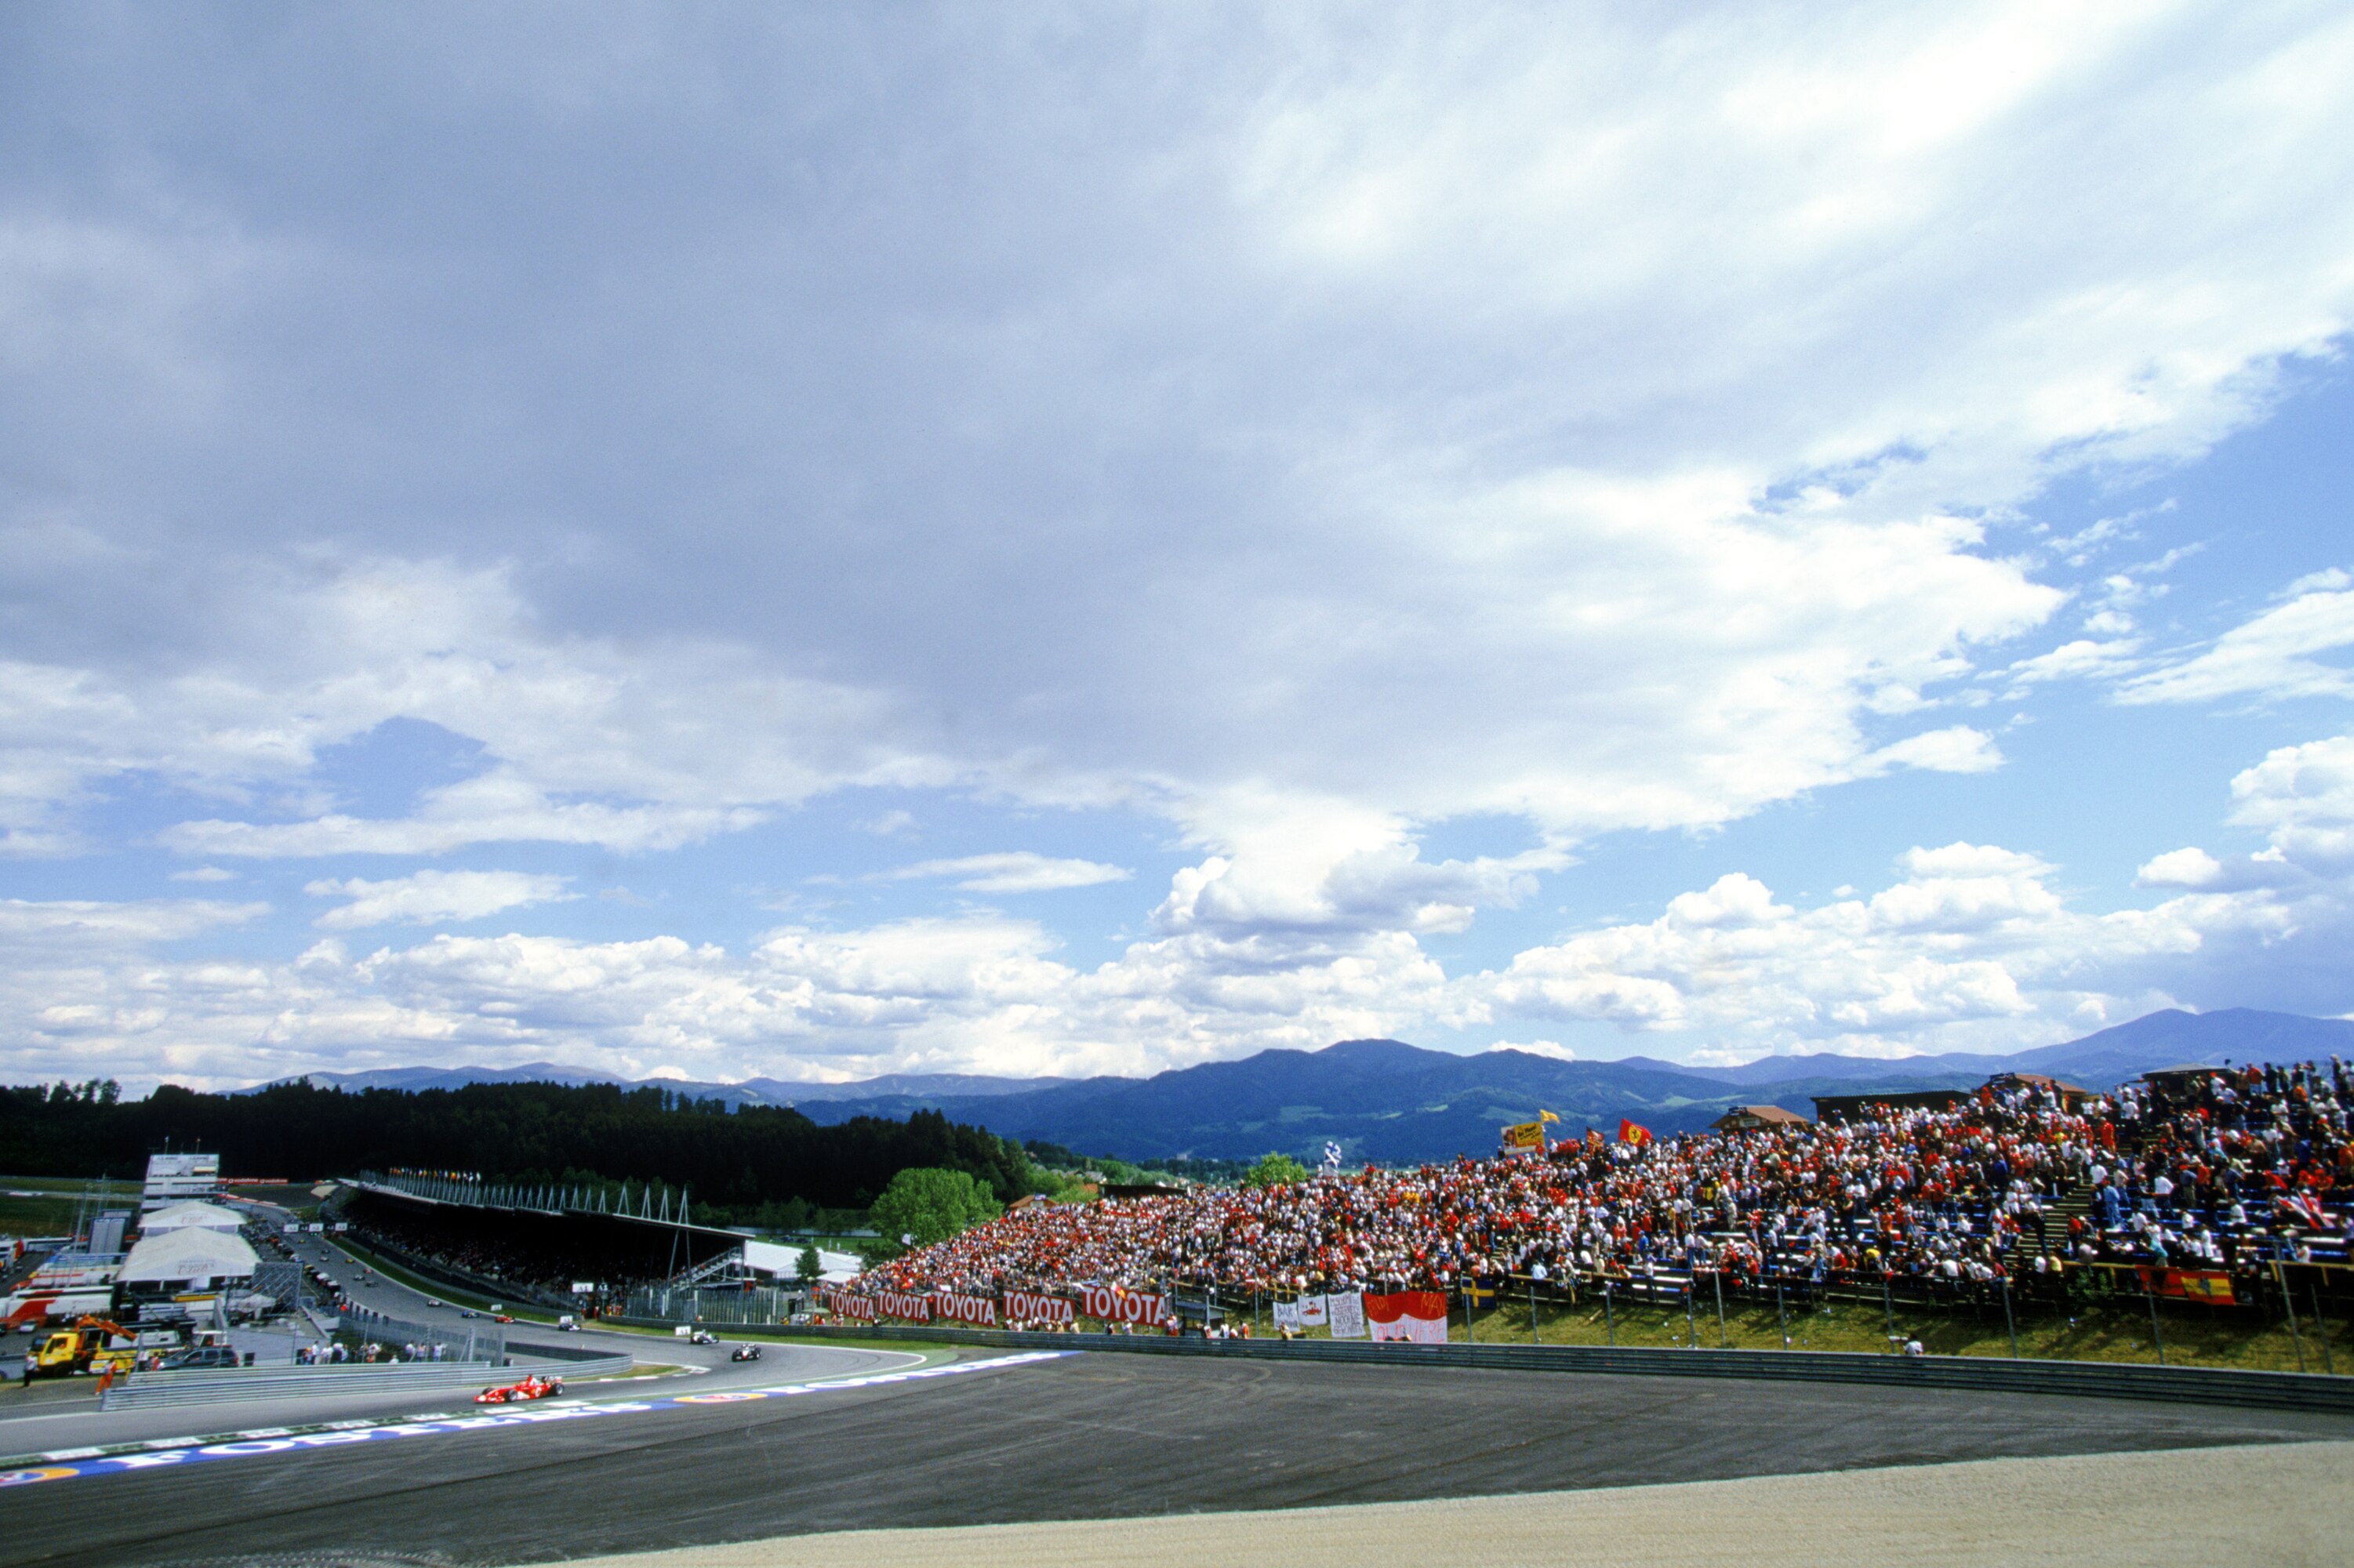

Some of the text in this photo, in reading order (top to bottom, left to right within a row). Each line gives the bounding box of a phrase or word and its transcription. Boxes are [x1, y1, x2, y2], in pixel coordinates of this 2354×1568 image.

[829, 1291, 874, 1319] TOYOTA
[877, 1290, 929, 1320] TOYOTA
[934, 1291, 996, 1325] TOYOTA
[1004, 1291, 1073, 1325] TOYOTA
[1082, 1287, 1165, 1325] TOYOTA
[96, 1400, 652, 1469] FOSTER'S
